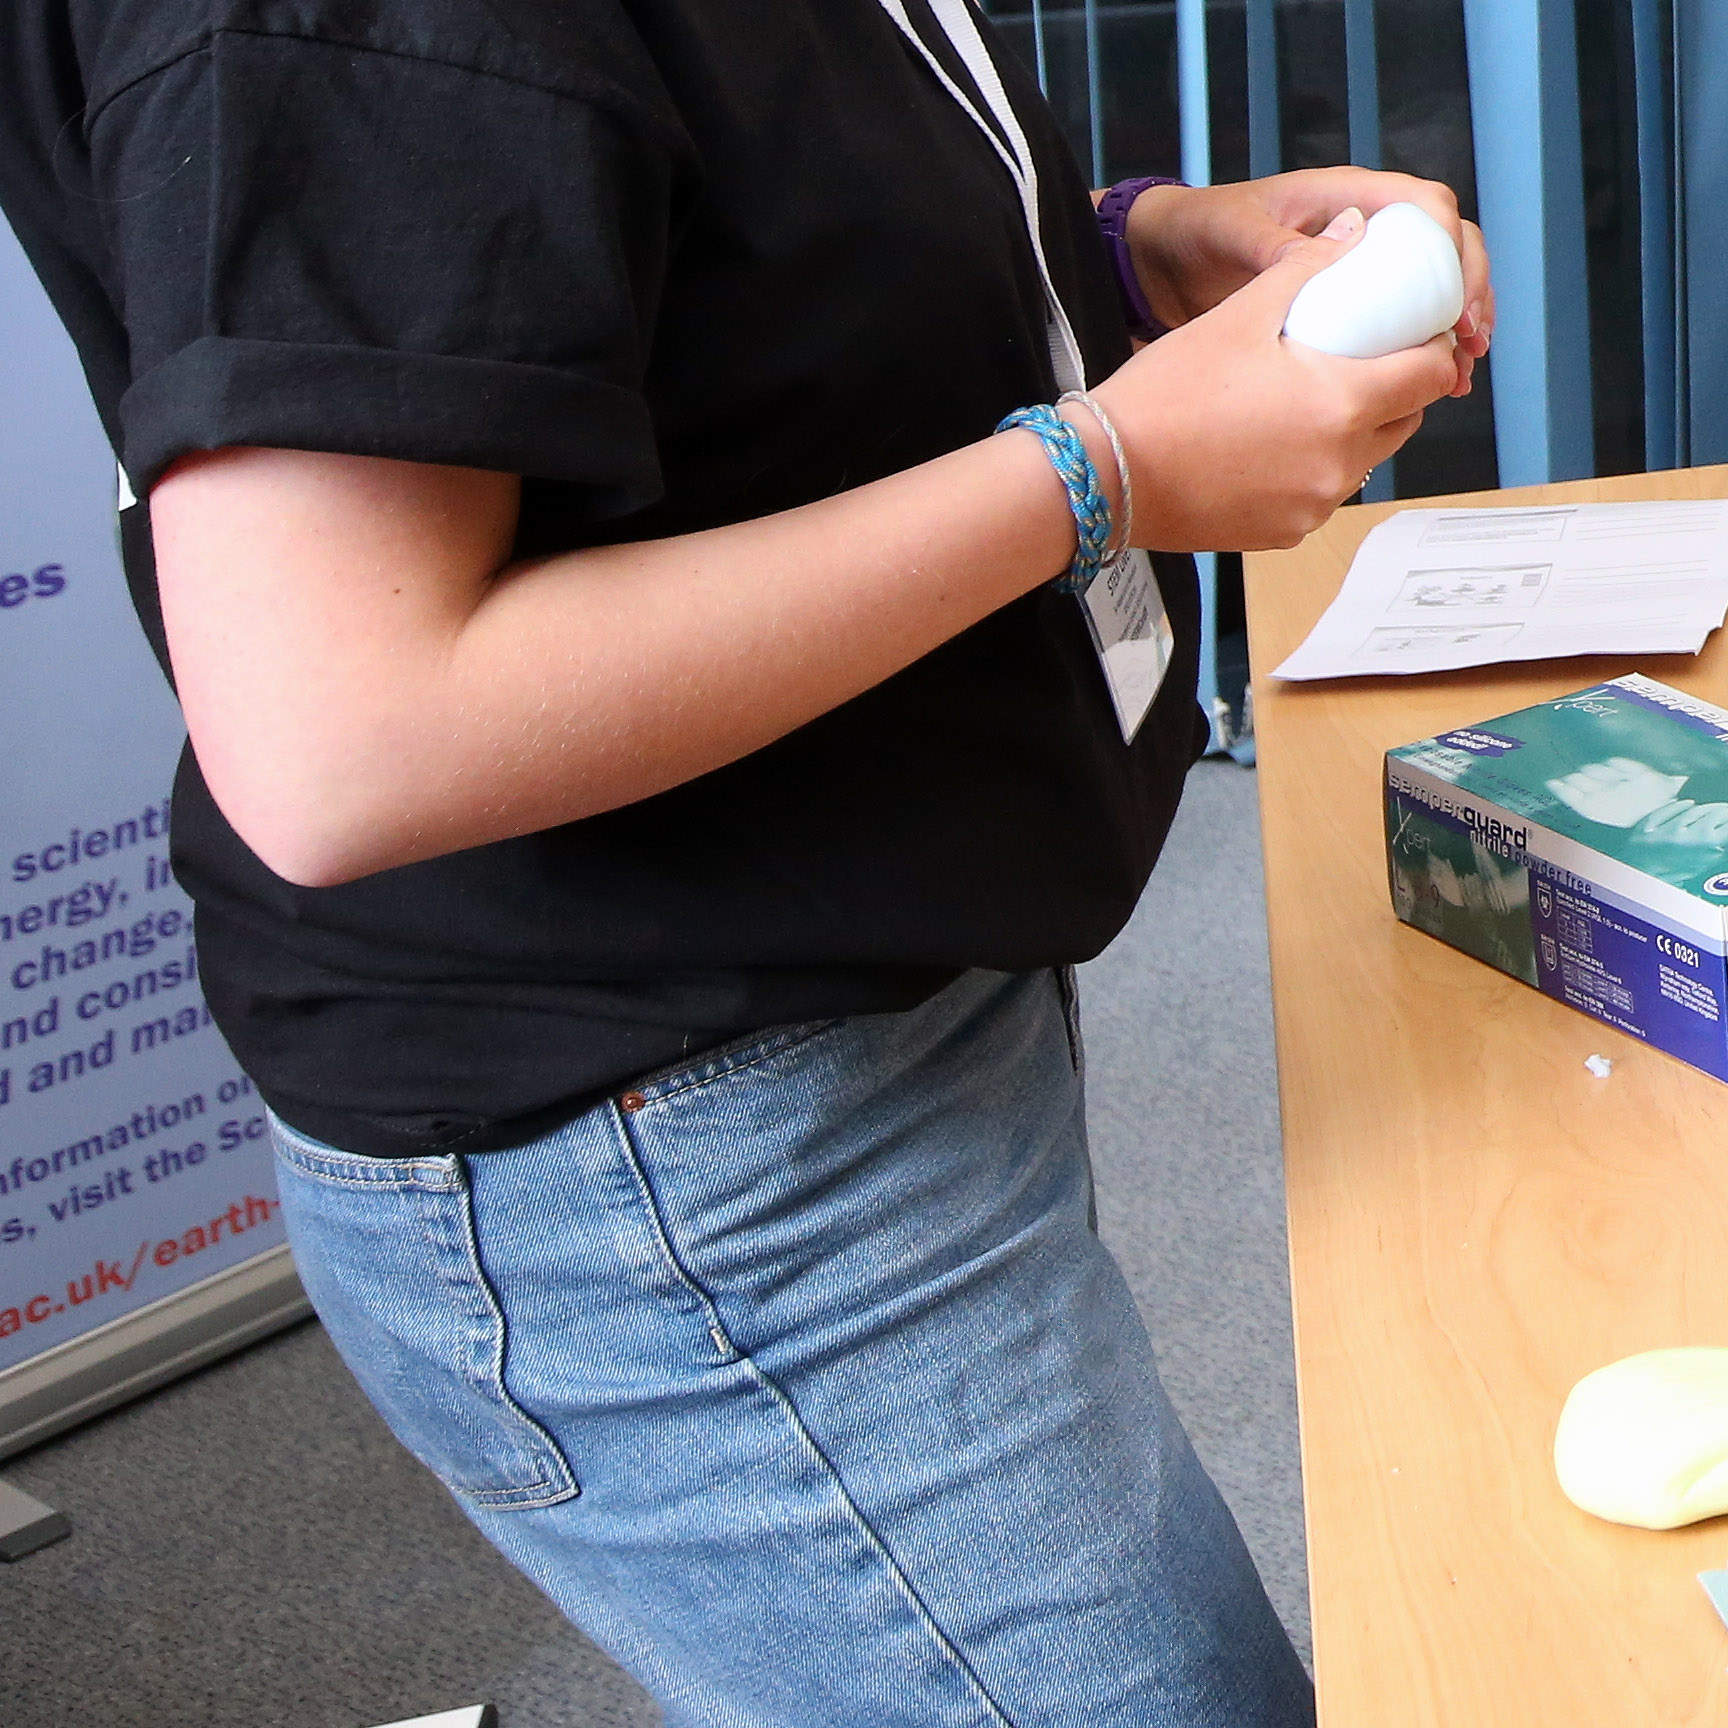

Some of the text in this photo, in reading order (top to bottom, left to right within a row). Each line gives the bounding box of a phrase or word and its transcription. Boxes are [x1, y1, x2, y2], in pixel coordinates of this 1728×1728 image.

[1469, 828, 1592, 896] nitrile powder free
[1673, 941, 1701, 969] 0321
[28, 1029, 115, 1093] and
[47, 1166, 134, 1222] visit
[144, 1141, 207, 1183] the
